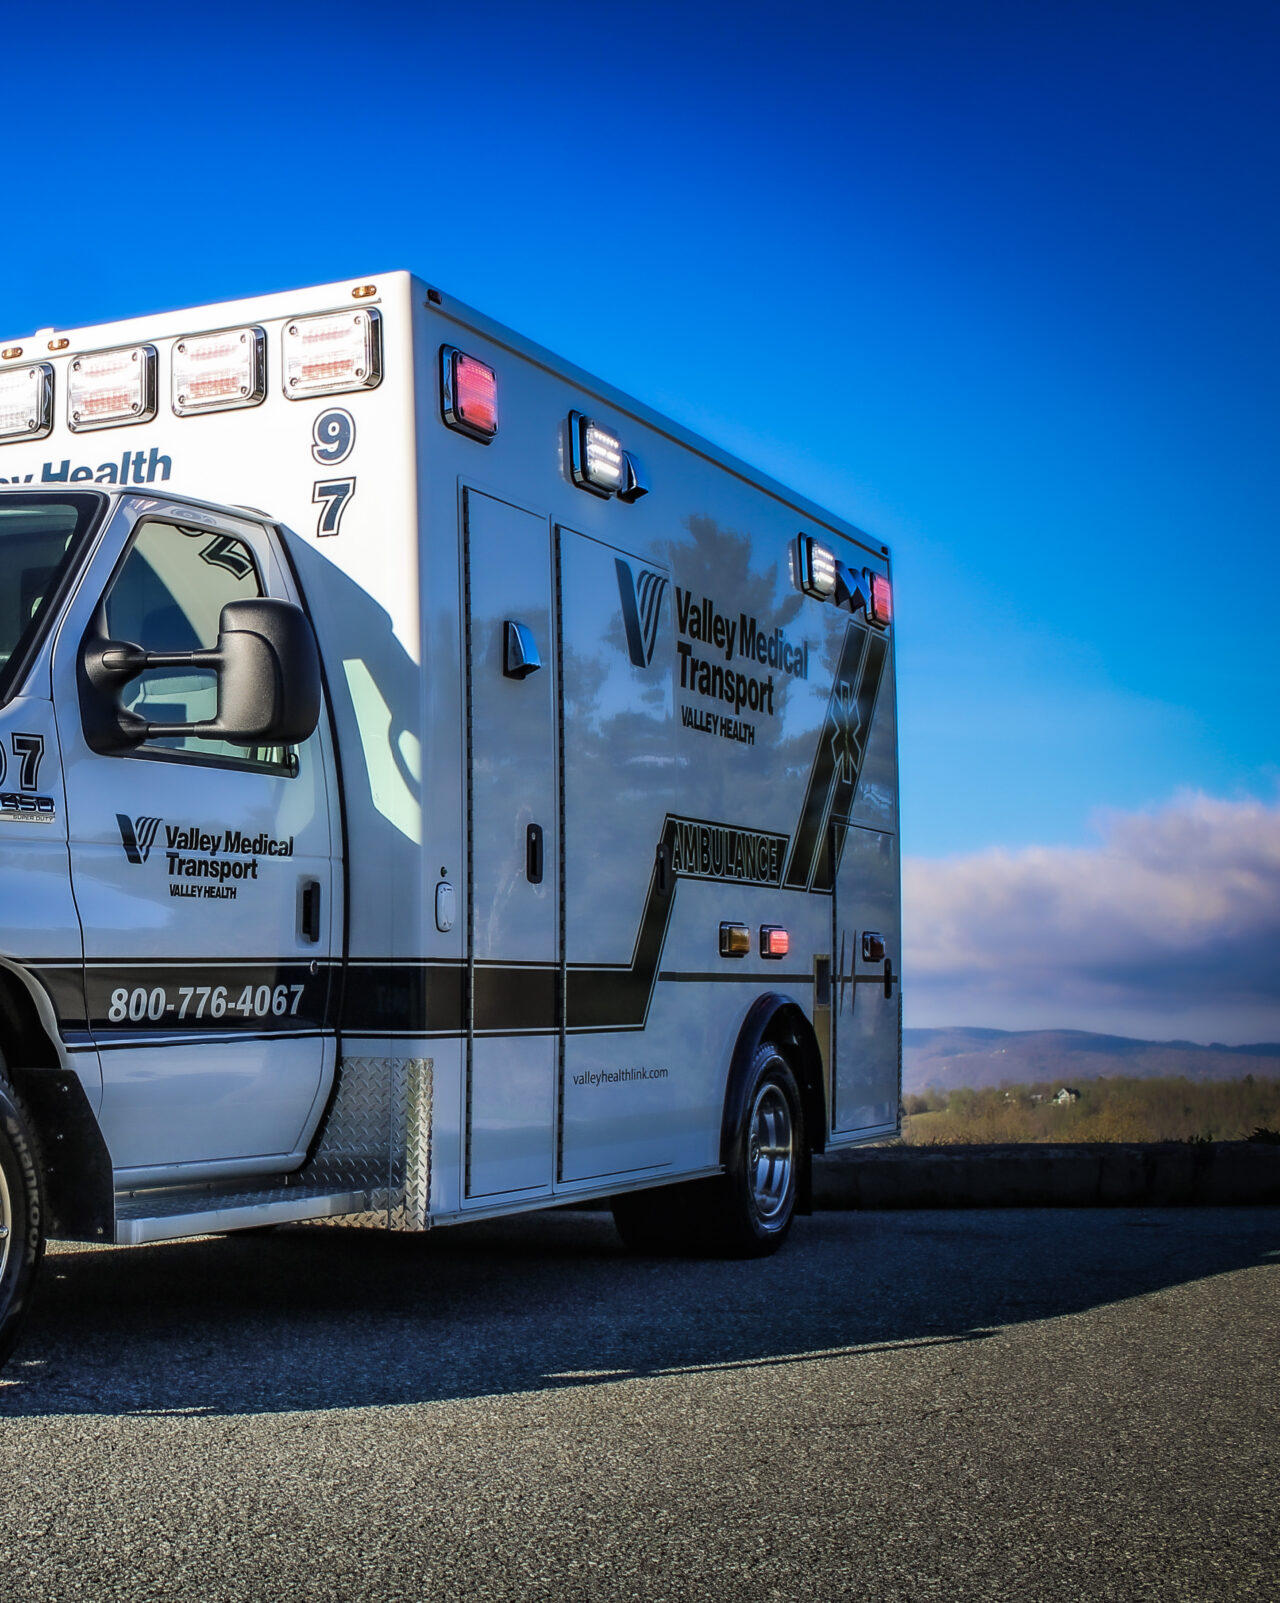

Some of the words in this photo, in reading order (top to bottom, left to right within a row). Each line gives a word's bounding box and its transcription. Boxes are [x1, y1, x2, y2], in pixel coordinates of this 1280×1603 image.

[41, 447, 173, 486] Health
[675, 586, 737, 661] Valley
[739, 613, 808, 681] Medical
[677, 640, 774, 716] Transport
[681, 705, 718, 736] VALLEY
[719, 716, 755, 746] HEALTH
[36, 815, 54, 823] DUTY
[165, 825, 223, 857] Valley
[223, 830, 294, 857] Medical
[671, 821, 779, 884] AMBULANCE
[166, 851, 259, 884] Transport
[169, 884, 204, 898] VALLEY
[204, 886, 238, 900] HEALTH
[108, 984, 305, 1023] 800-776-4067
[572, 1067, 669, 1087] valleyhealthlink.com
